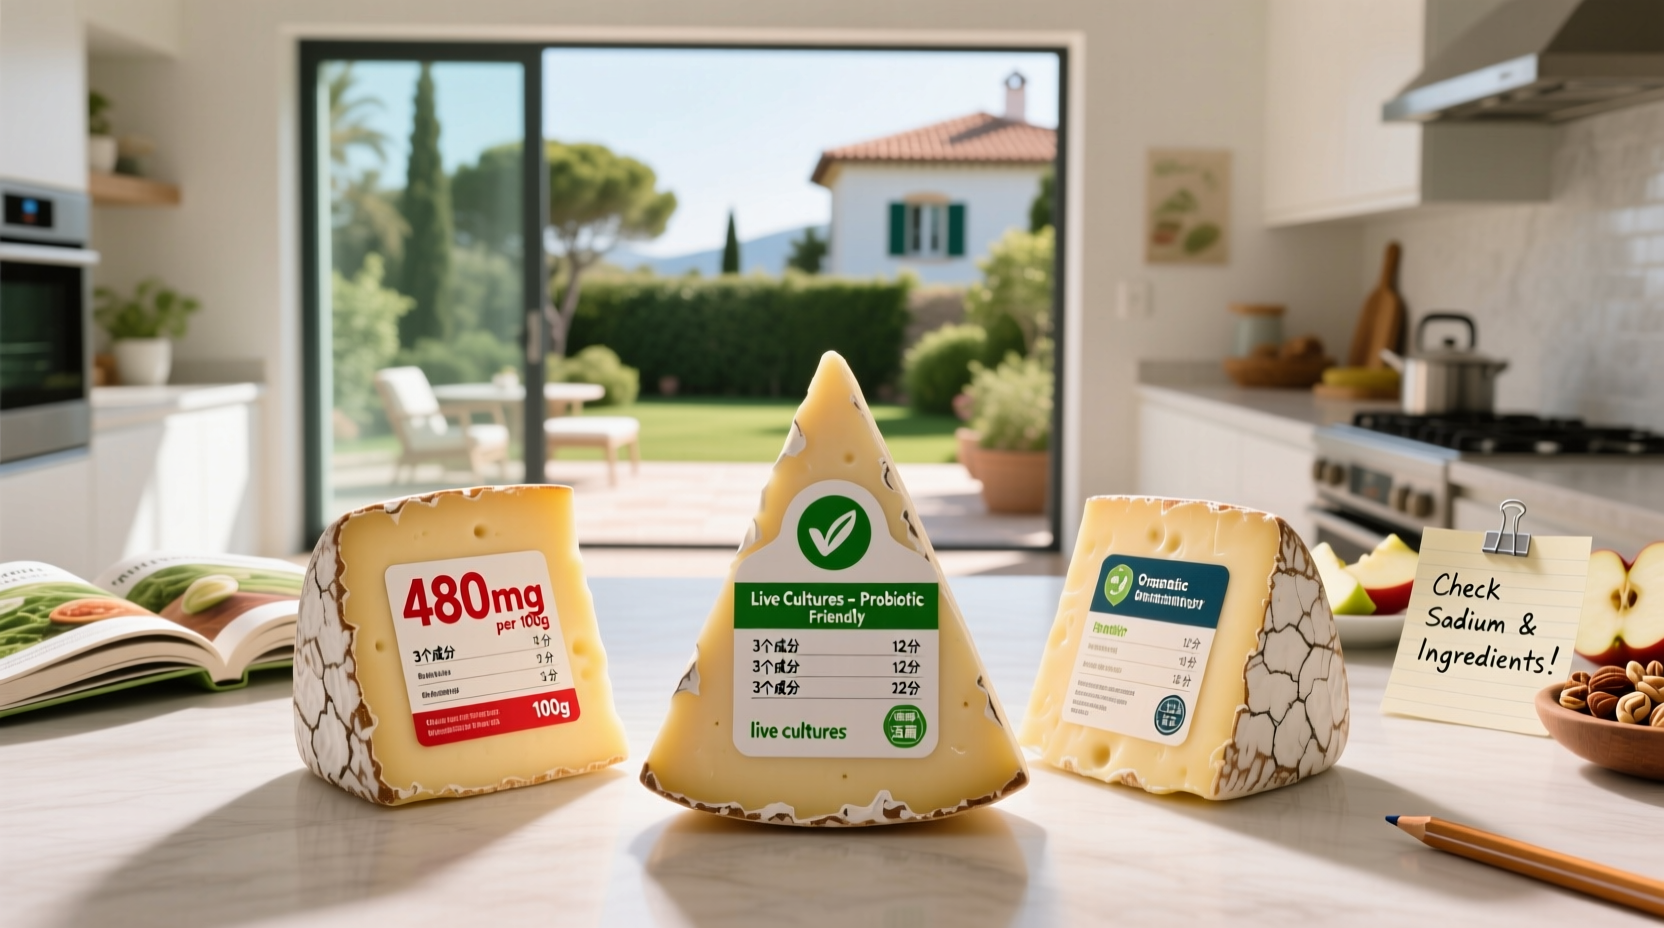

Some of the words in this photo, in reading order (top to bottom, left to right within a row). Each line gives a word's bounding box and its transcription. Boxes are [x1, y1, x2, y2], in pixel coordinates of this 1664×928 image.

[1433, 572, 1501, 600] Check
[403, 571, 545, 626] 480mg
[751, 591, 780, 606] Live
[783, 591, 844, 606] Cultures
[860, 591, 925, 607] Probiotic
[496, 618, 516, 635] per
[520, 614, 550, 630] 100g
[809, 608, 865, 627] Friendly
[1425, 606, 1505, 633] Sadium
[1519, 612, 1537, 636] &
[892, 639, 921, 654] 12分
[1418, 638, 1560, 675] Ingredients!
[892, 660, 921, 674] 12分
[532, 698, 570, 718] 100g
[751, 722, 778, 739] live
[782, 722, 847, 740] cultures
